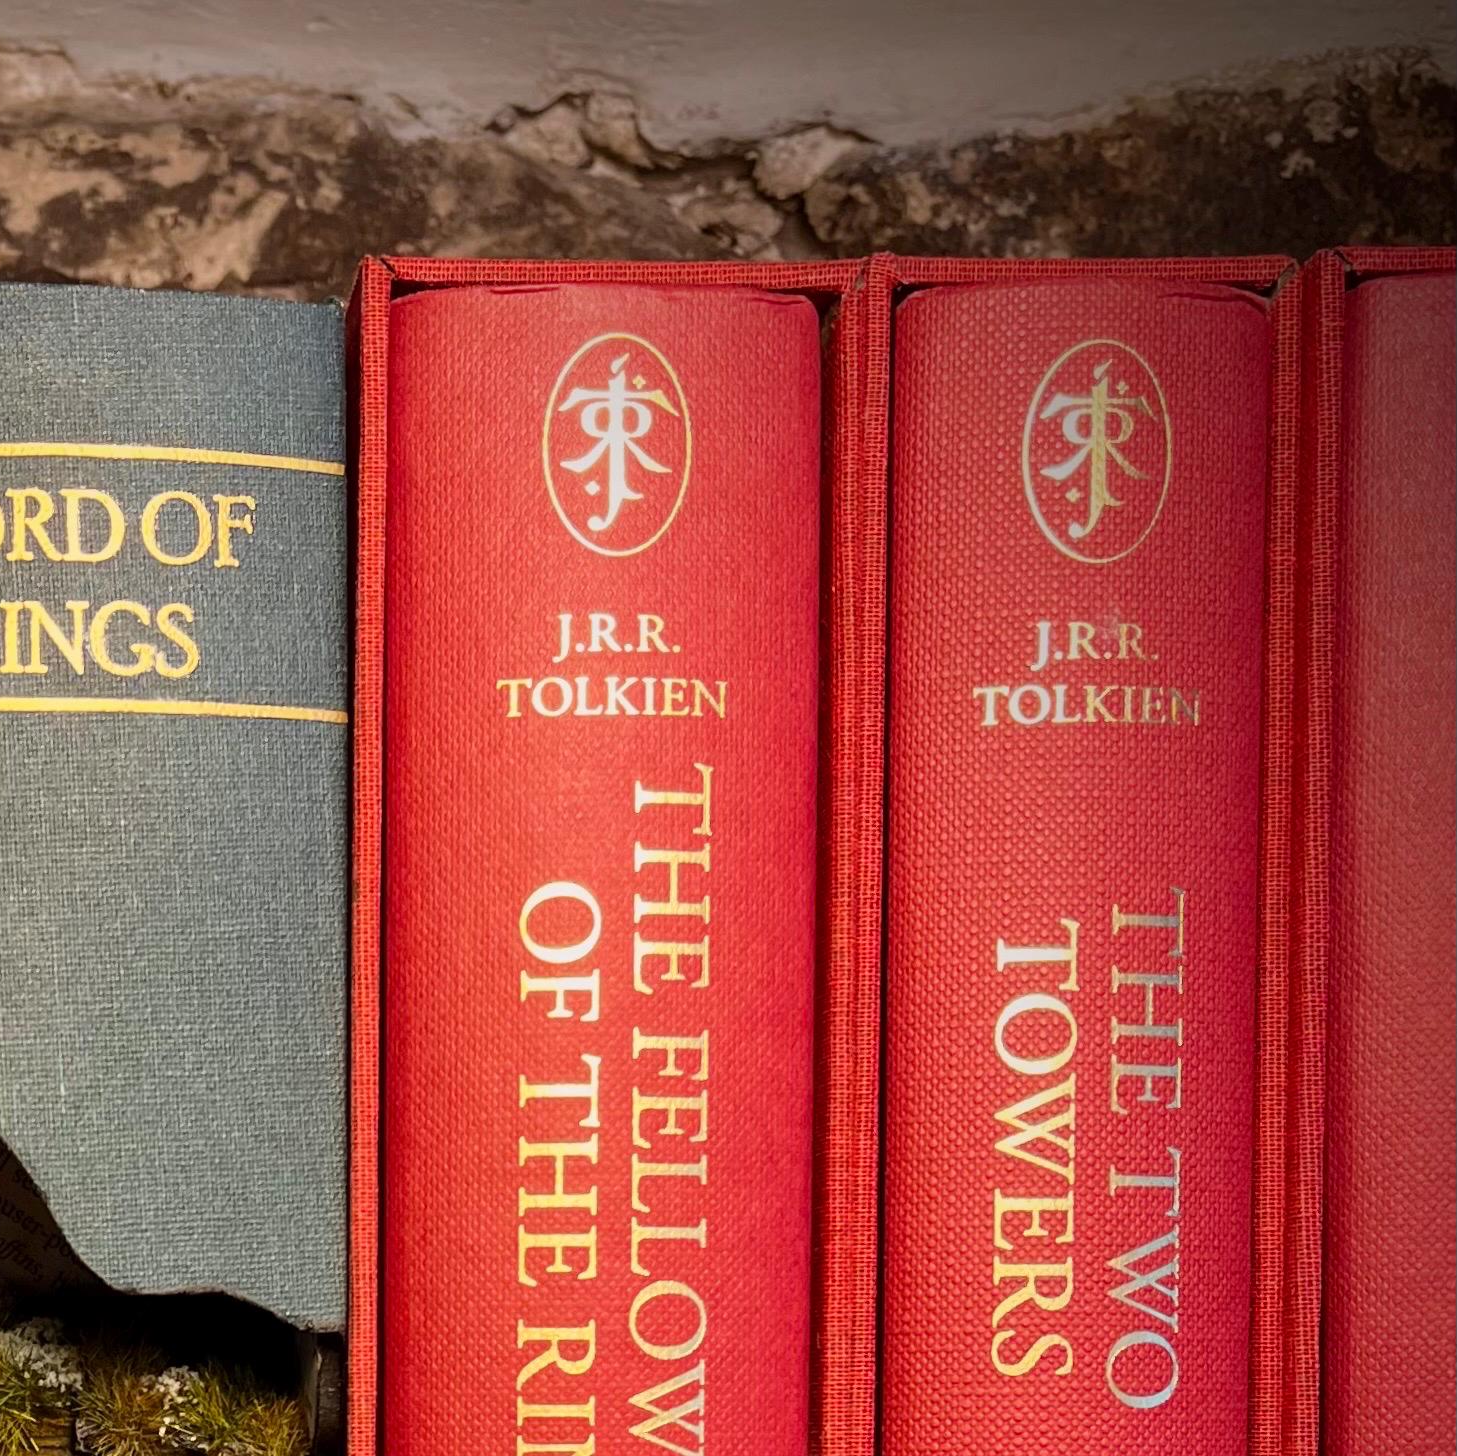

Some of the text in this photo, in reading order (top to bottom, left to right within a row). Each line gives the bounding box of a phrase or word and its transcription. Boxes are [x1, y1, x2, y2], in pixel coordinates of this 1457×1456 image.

[140, 490, 257, 569] OF
[552, 613, 682, 663] J.R.R.
[1030, 620, 1159, 672] J.R.R.
[496, 677, 729, 719] TOLKIEN
[972, 683, 1201, 727] TOLKIEN
[632, 762, 715, 995] THE
[517, 878, 603, 1024] OF
[516, 1054, 603, 1288] THE
[990, 917, 1081, 1377] TOWERS
[1105, 885, 1186, 1409] THE TWO
